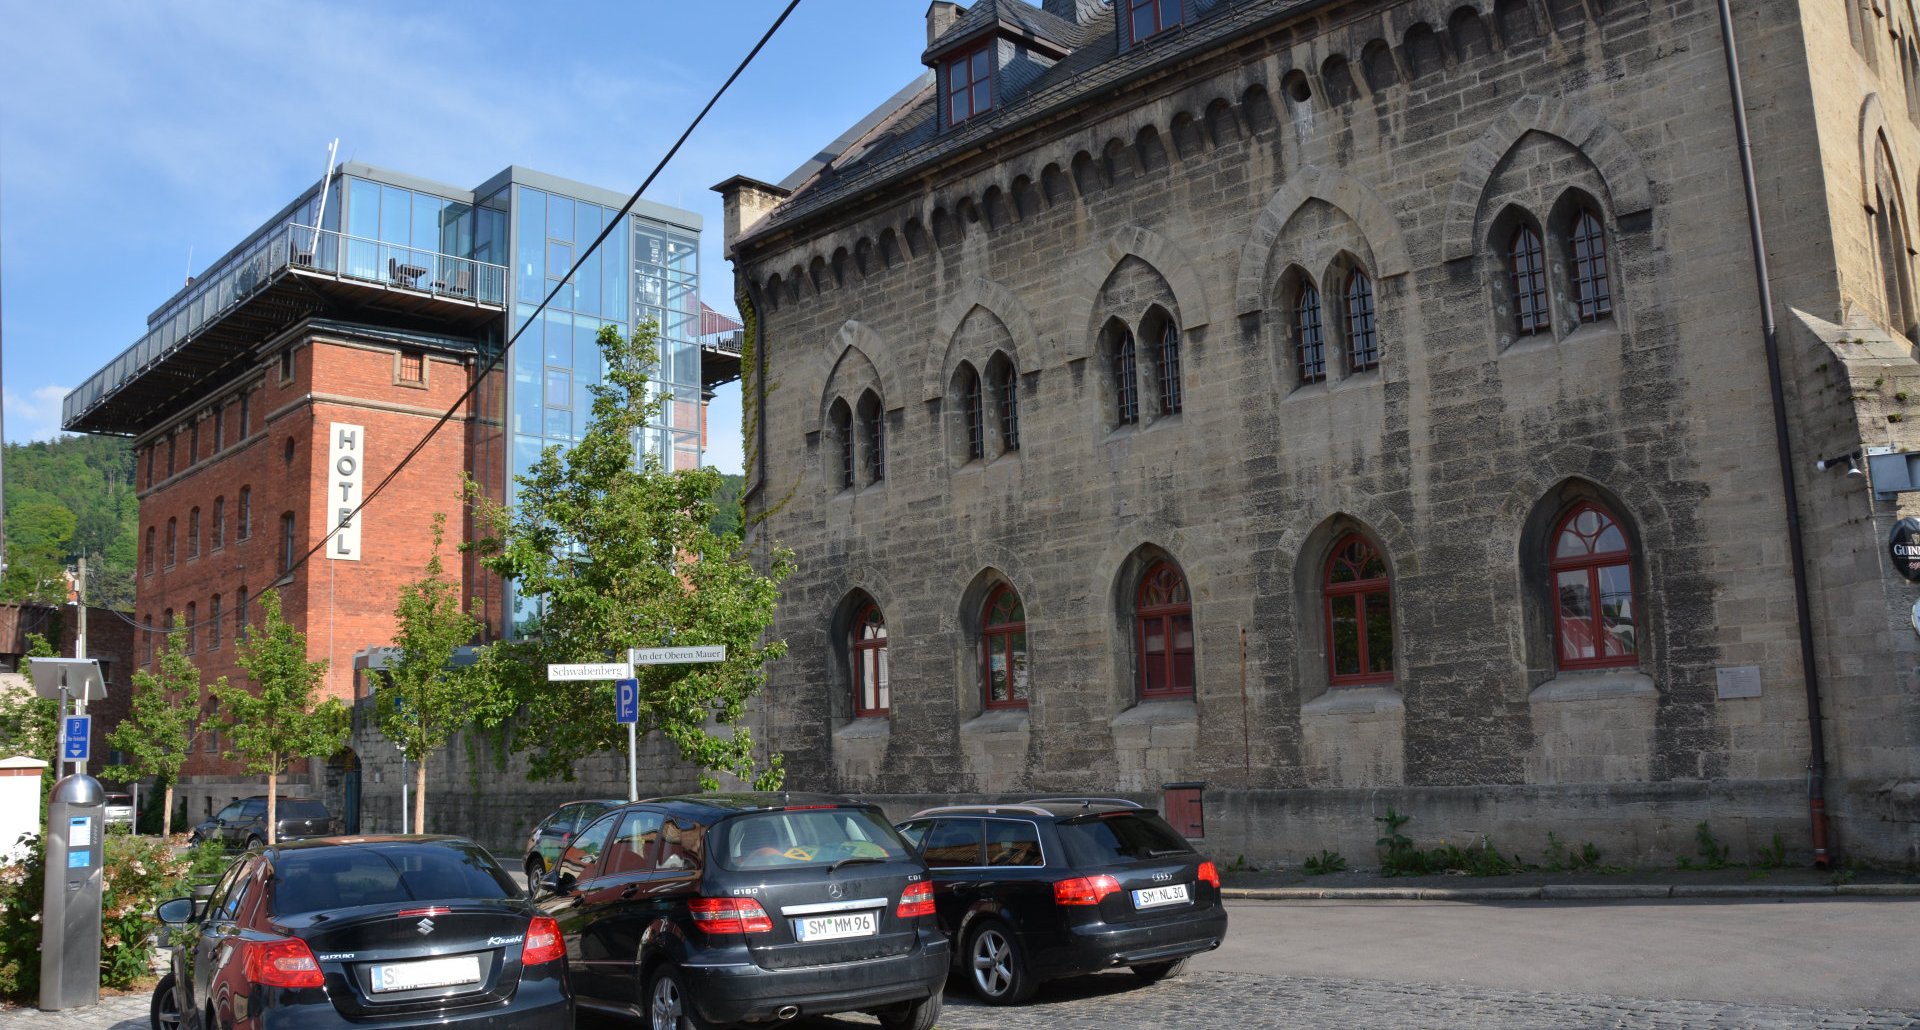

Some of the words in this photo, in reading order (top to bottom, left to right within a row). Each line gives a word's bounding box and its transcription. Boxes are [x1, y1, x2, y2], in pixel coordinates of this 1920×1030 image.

[337, 429, 356, 555] HOTEL
[1894, 544, 1920, 556] GUIN
[649, 652, 662, 660] der
[664, 651, 693, 660] Oberen
[695, 650, 721, 658] Mauer
[552, 665, 623, 677] Schwabenberg
[620, 685, 633, 718] P
[1142, 890, 1156, 903] SM
[1159, 888, 1172, 900] NL
[1172, 886, 1184, 899] 30
[809, 919, 828, 935] SM
[834, 917, 852, 933] MM
[854, 915, 870, 931] 96
[319, 953, 355, 961] SUZUKI
